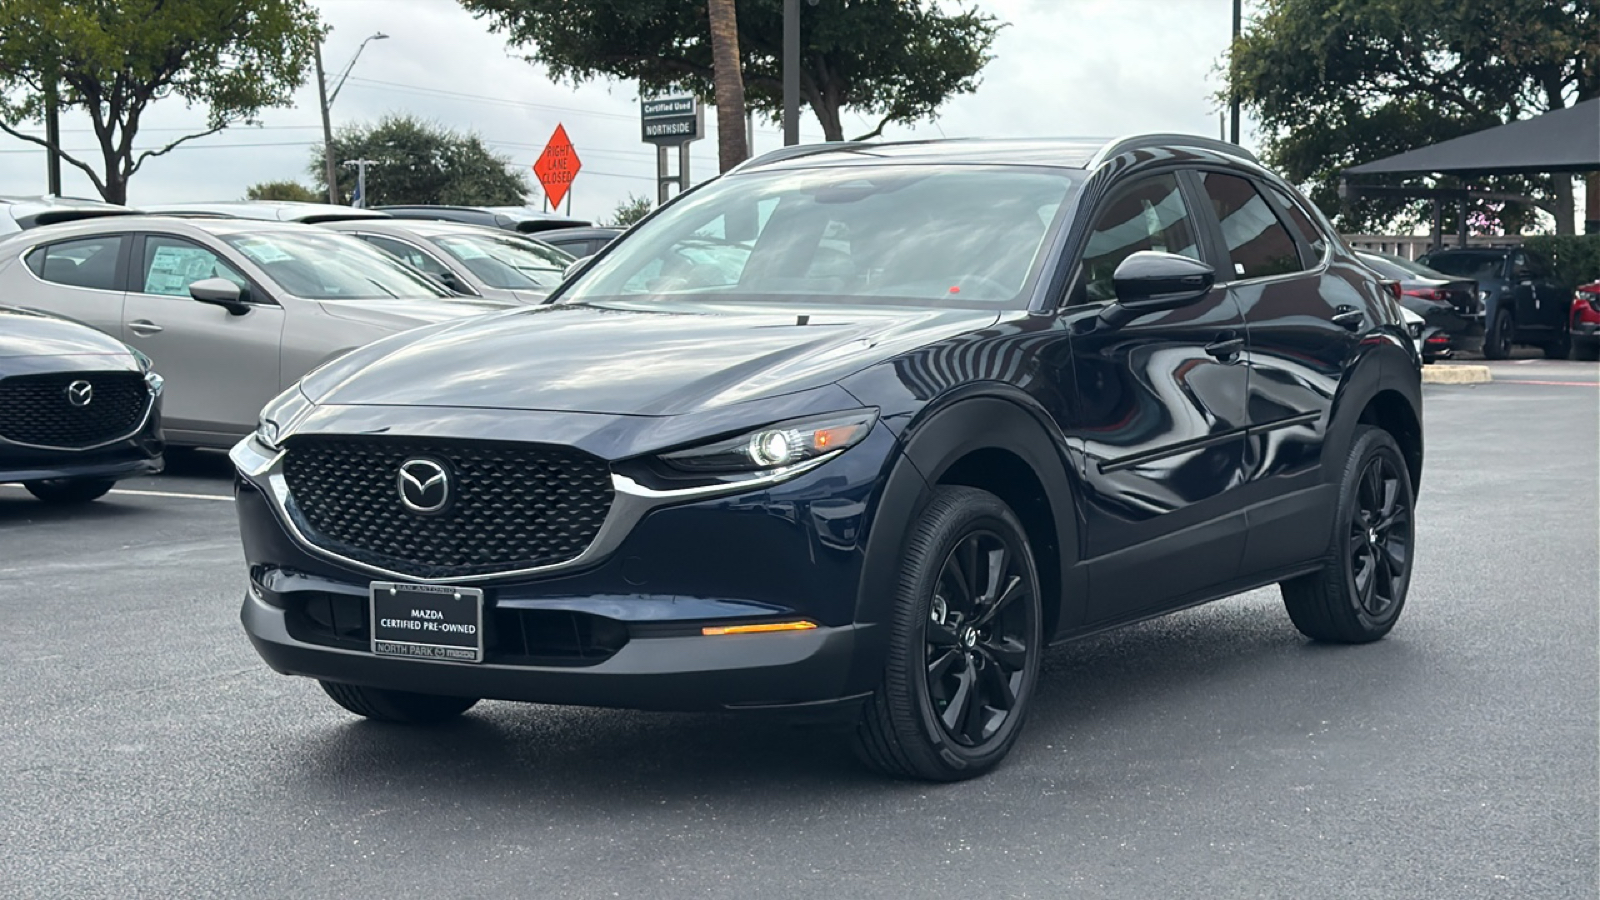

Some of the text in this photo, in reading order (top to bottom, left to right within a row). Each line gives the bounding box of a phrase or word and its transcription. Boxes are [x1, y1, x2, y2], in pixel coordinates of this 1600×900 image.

[644, 101, 691, 113] Certified Used
[646, 122, 690, 136] NORTHSIDE
[547, 145, 570, 157] RIGHT
[549, 158, 567, 170] LANE
[543, 171, 571, 184] CLOSED
[411, 609, 444, 620] MAZDA
[380, 618, 476, 634] CERTIFIED PRE-OWNED
[377, 643, 475, 659] NORTH PARK mazda
